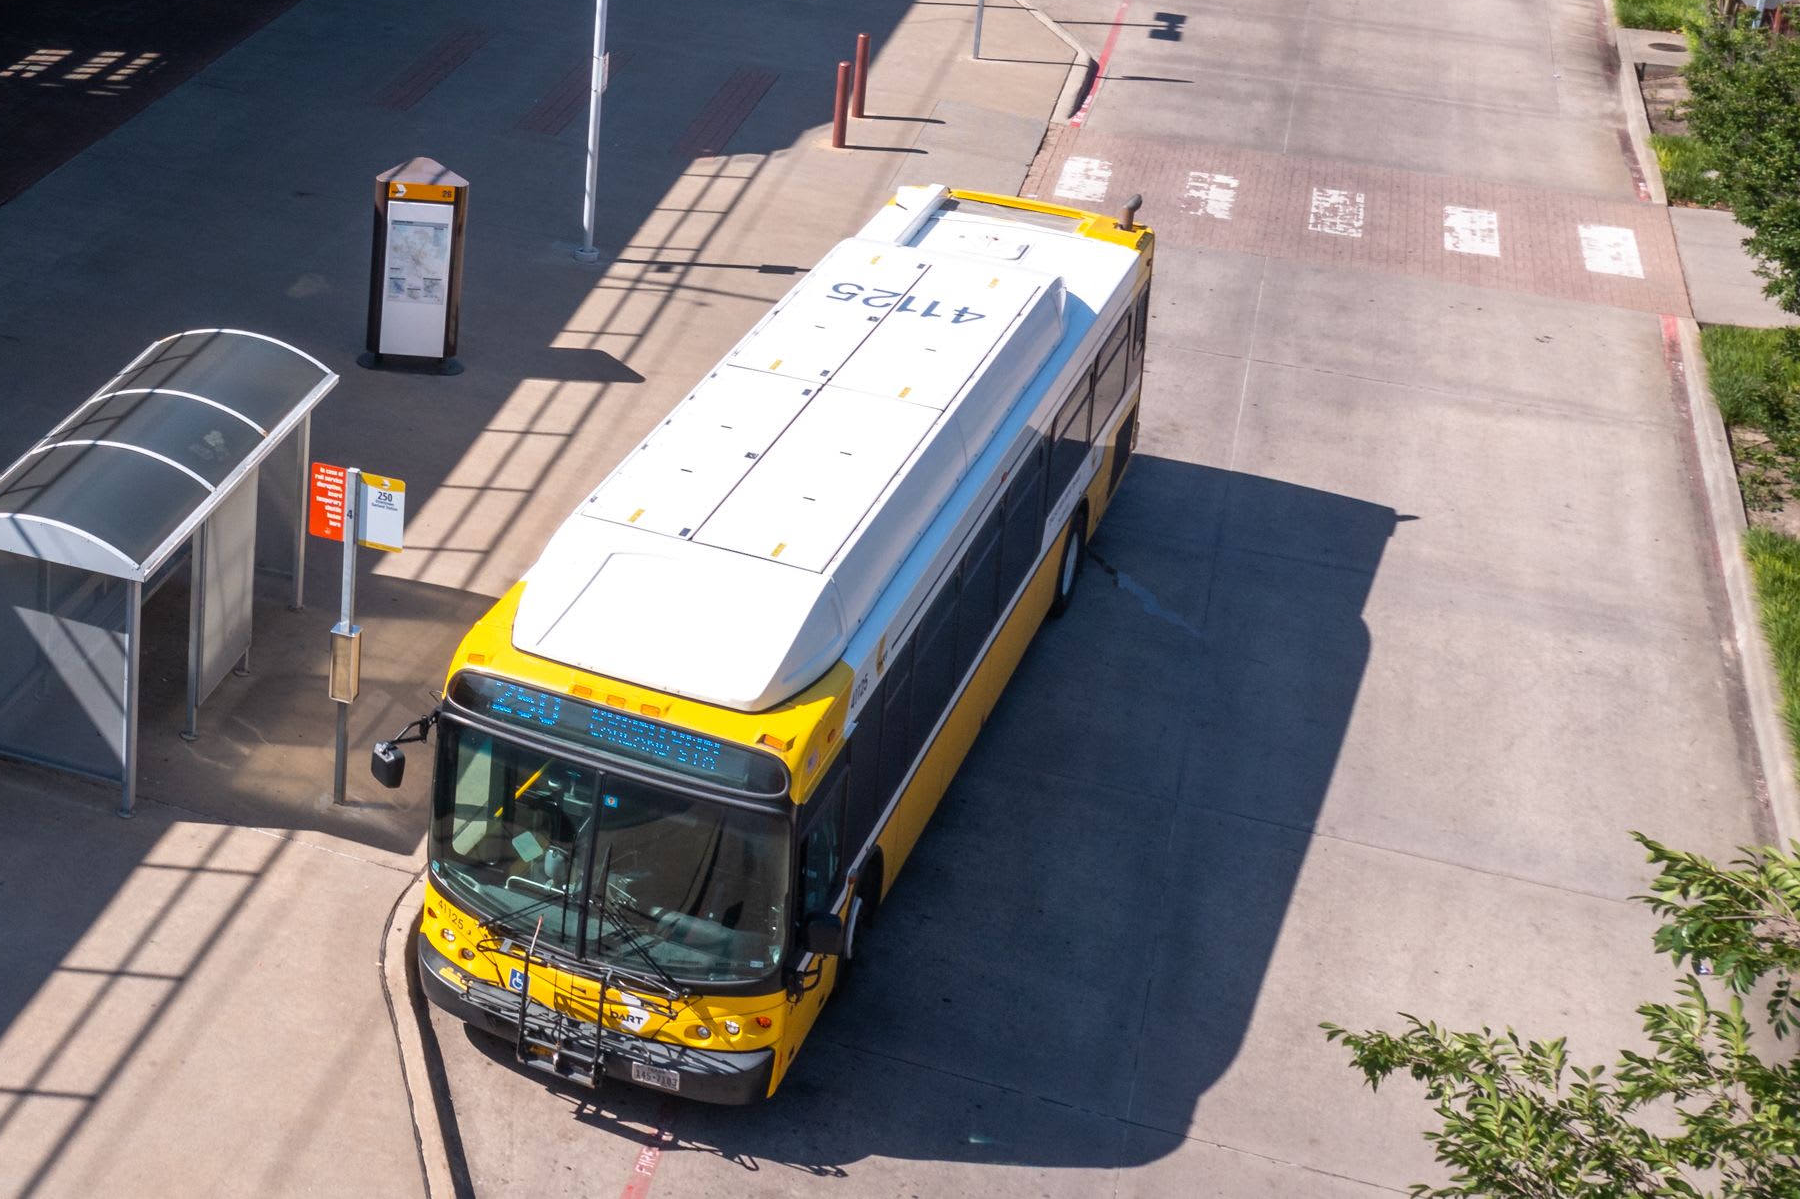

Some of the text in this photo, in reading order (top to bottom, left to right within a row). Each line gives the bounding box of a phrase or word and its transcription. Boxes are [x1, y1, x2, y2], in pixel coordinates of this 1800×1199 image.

[825, 282, 987, 324] 41125
[377, 491, 393, 502] 250
[346, 509, 353, 519] 4
[491, 681, 561, 726] 250
[439, 899, 464, 930] 41125
[609, 1010, 644, 1025] DART
[635, 1146, 658, 1176] FIRE
